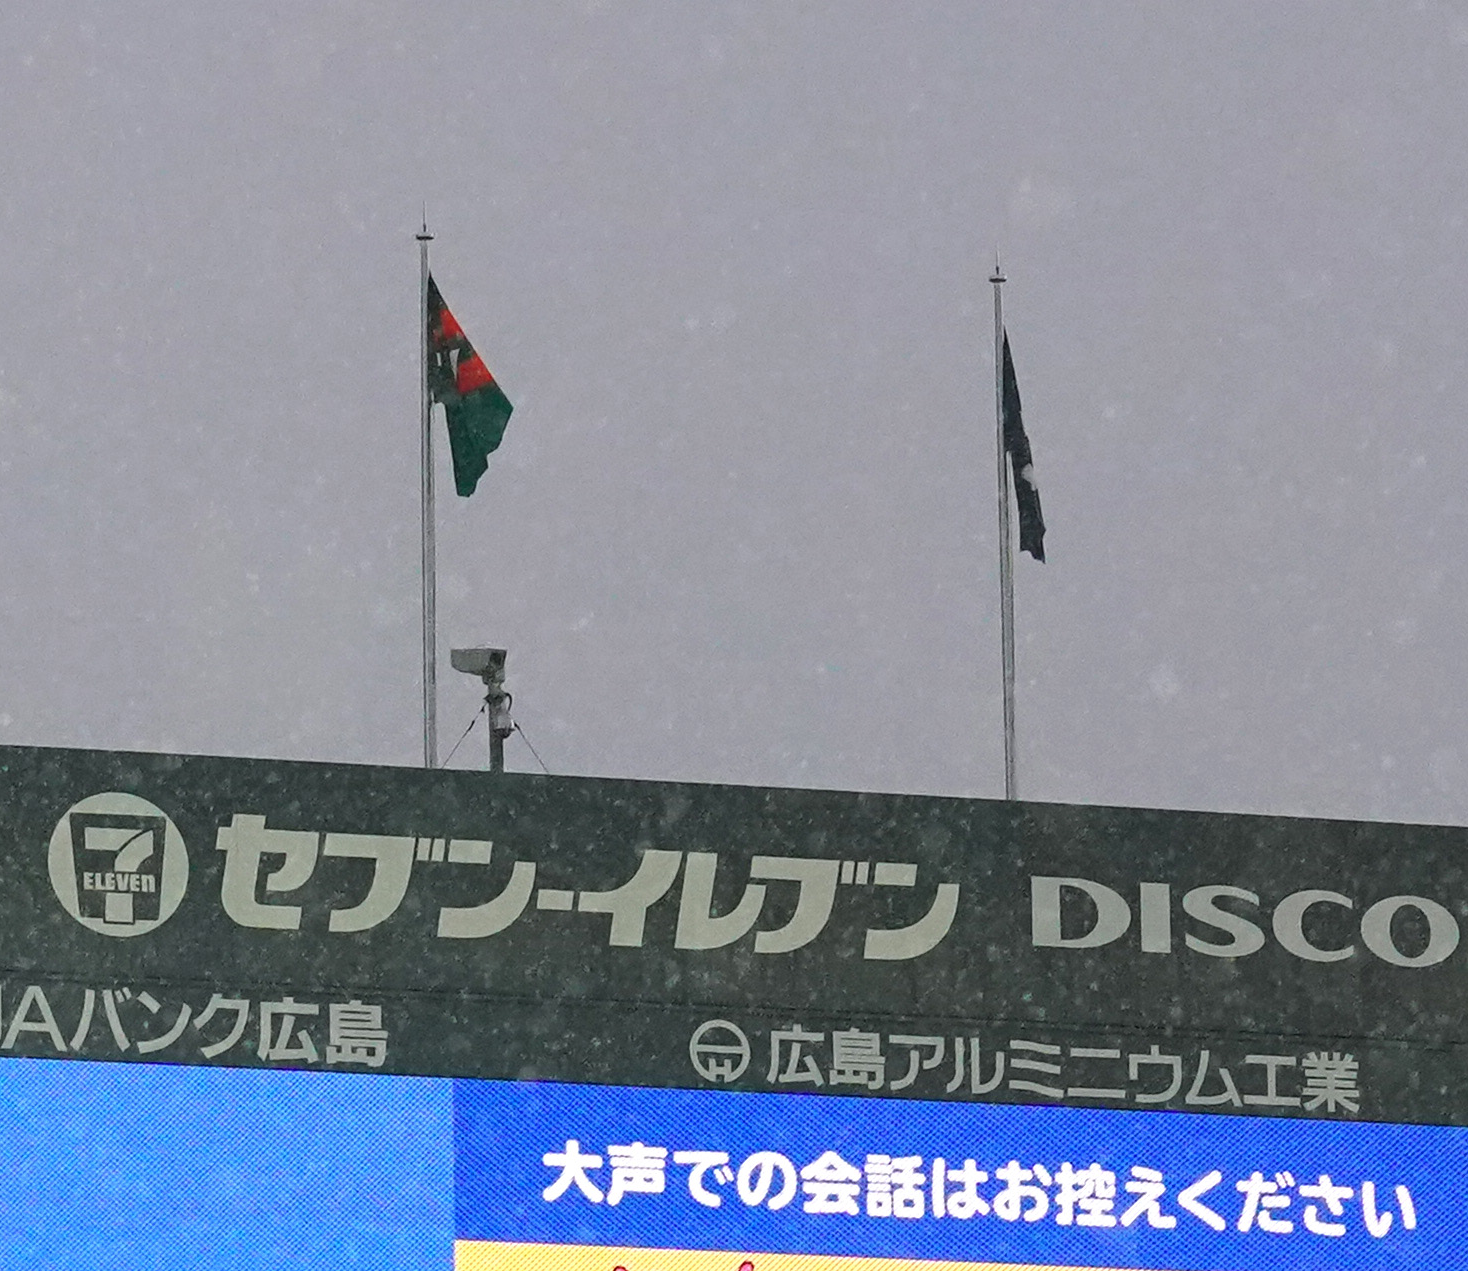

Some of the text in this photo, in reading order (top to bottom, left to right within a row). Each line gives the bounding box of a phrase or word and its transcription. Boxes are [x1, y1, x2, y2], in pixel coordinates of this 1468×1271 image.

[1031, 876, 1460, 968] DISCO
[768, 1026, 1360, 1114] 広島アルミニウム工業
[542, 1139, 1418, 1240] 大声での会話はお控えください
